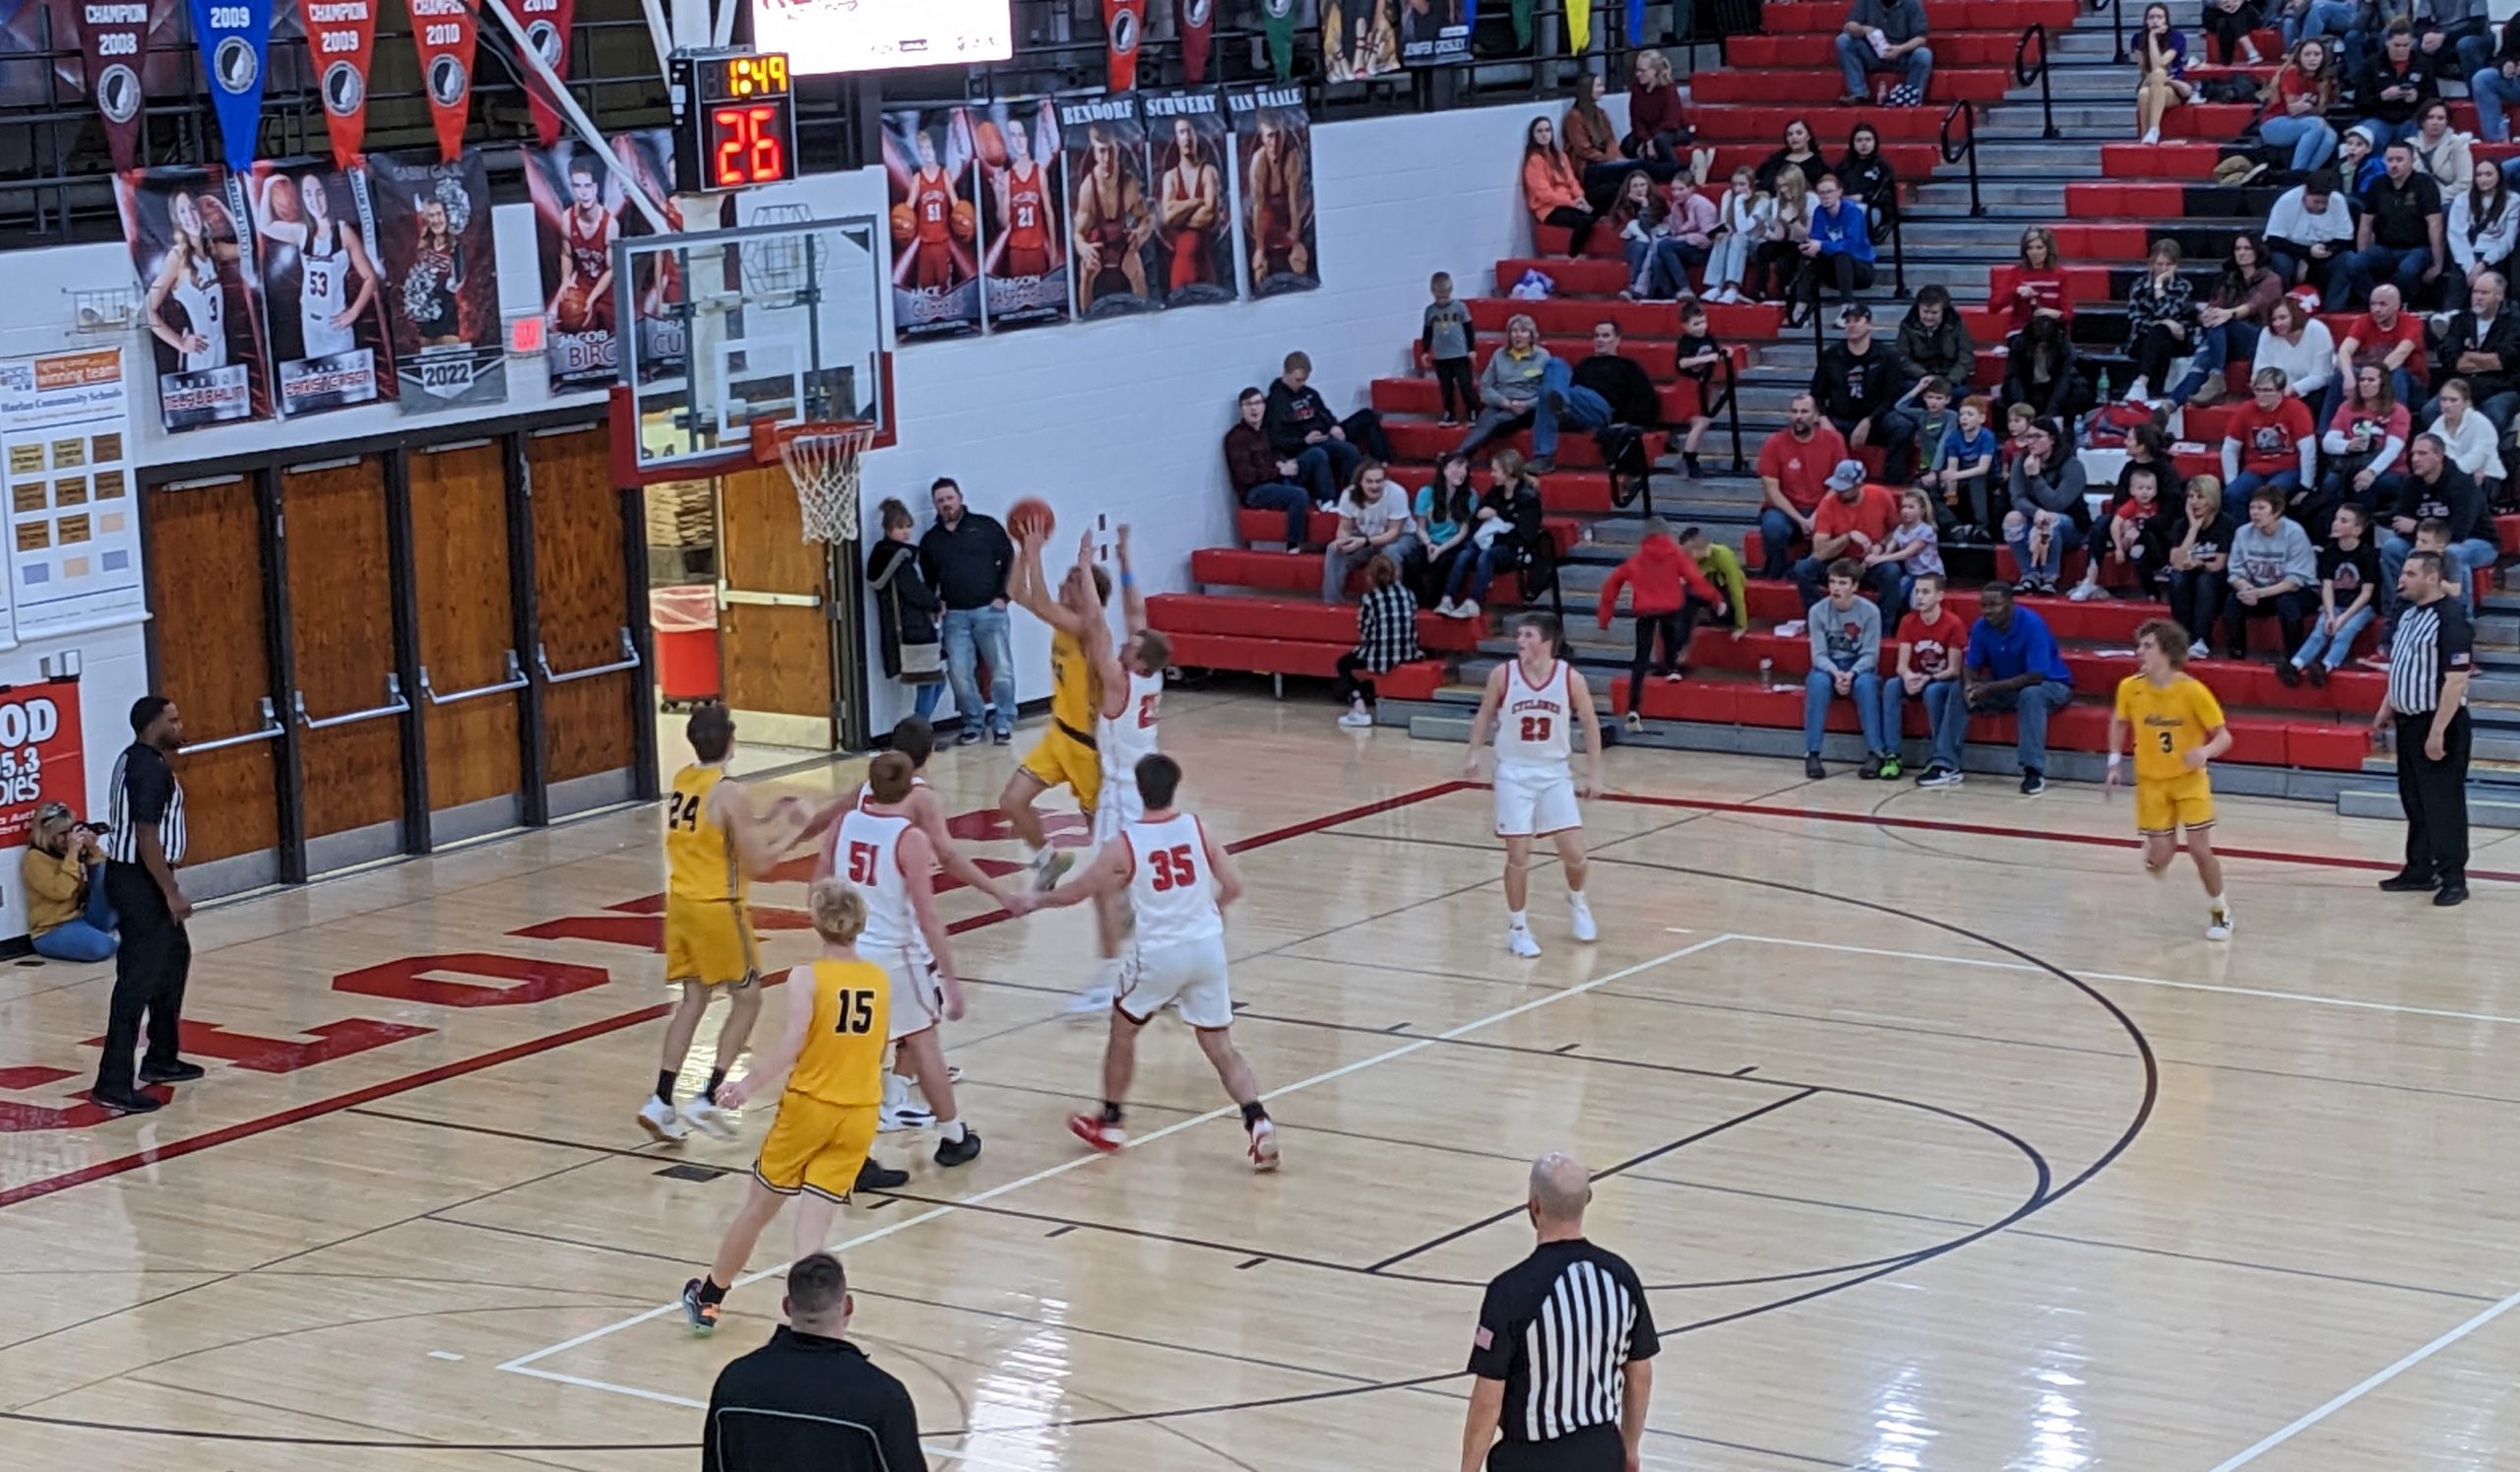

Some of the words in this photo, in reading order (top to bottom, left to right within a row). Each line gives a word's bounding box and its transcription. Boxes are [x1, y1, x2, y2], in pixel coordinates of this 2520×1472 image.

[85, 4, 148, 24] CHAMPION
[210, 6, 250, 29] 2009
[308, 2, 368, 22] CHAMPION
[321, 31, 359, 52] 2009
[425, 23, 461, 45] 2010
[729, 56, 788, 96] 1:49
[1061, 99, 1134, 125] BENDORF
[716, 107, 782, 185] 26
[1017, 206, 1035, 227] 21
[309, 272, 327, 297] 53
[558, 330, 608, 348] JACOB
[424, 363, 470, 387] 2022
[1520, 716, 1551, 741] 23
[2158, 732, 2174, 754] 3
[668, 791, 701, 833] 24
[848, 840, 880, 886] 51
[1148, 844, 1197, 893] 35
[835, 989, 875, 1035] 15
